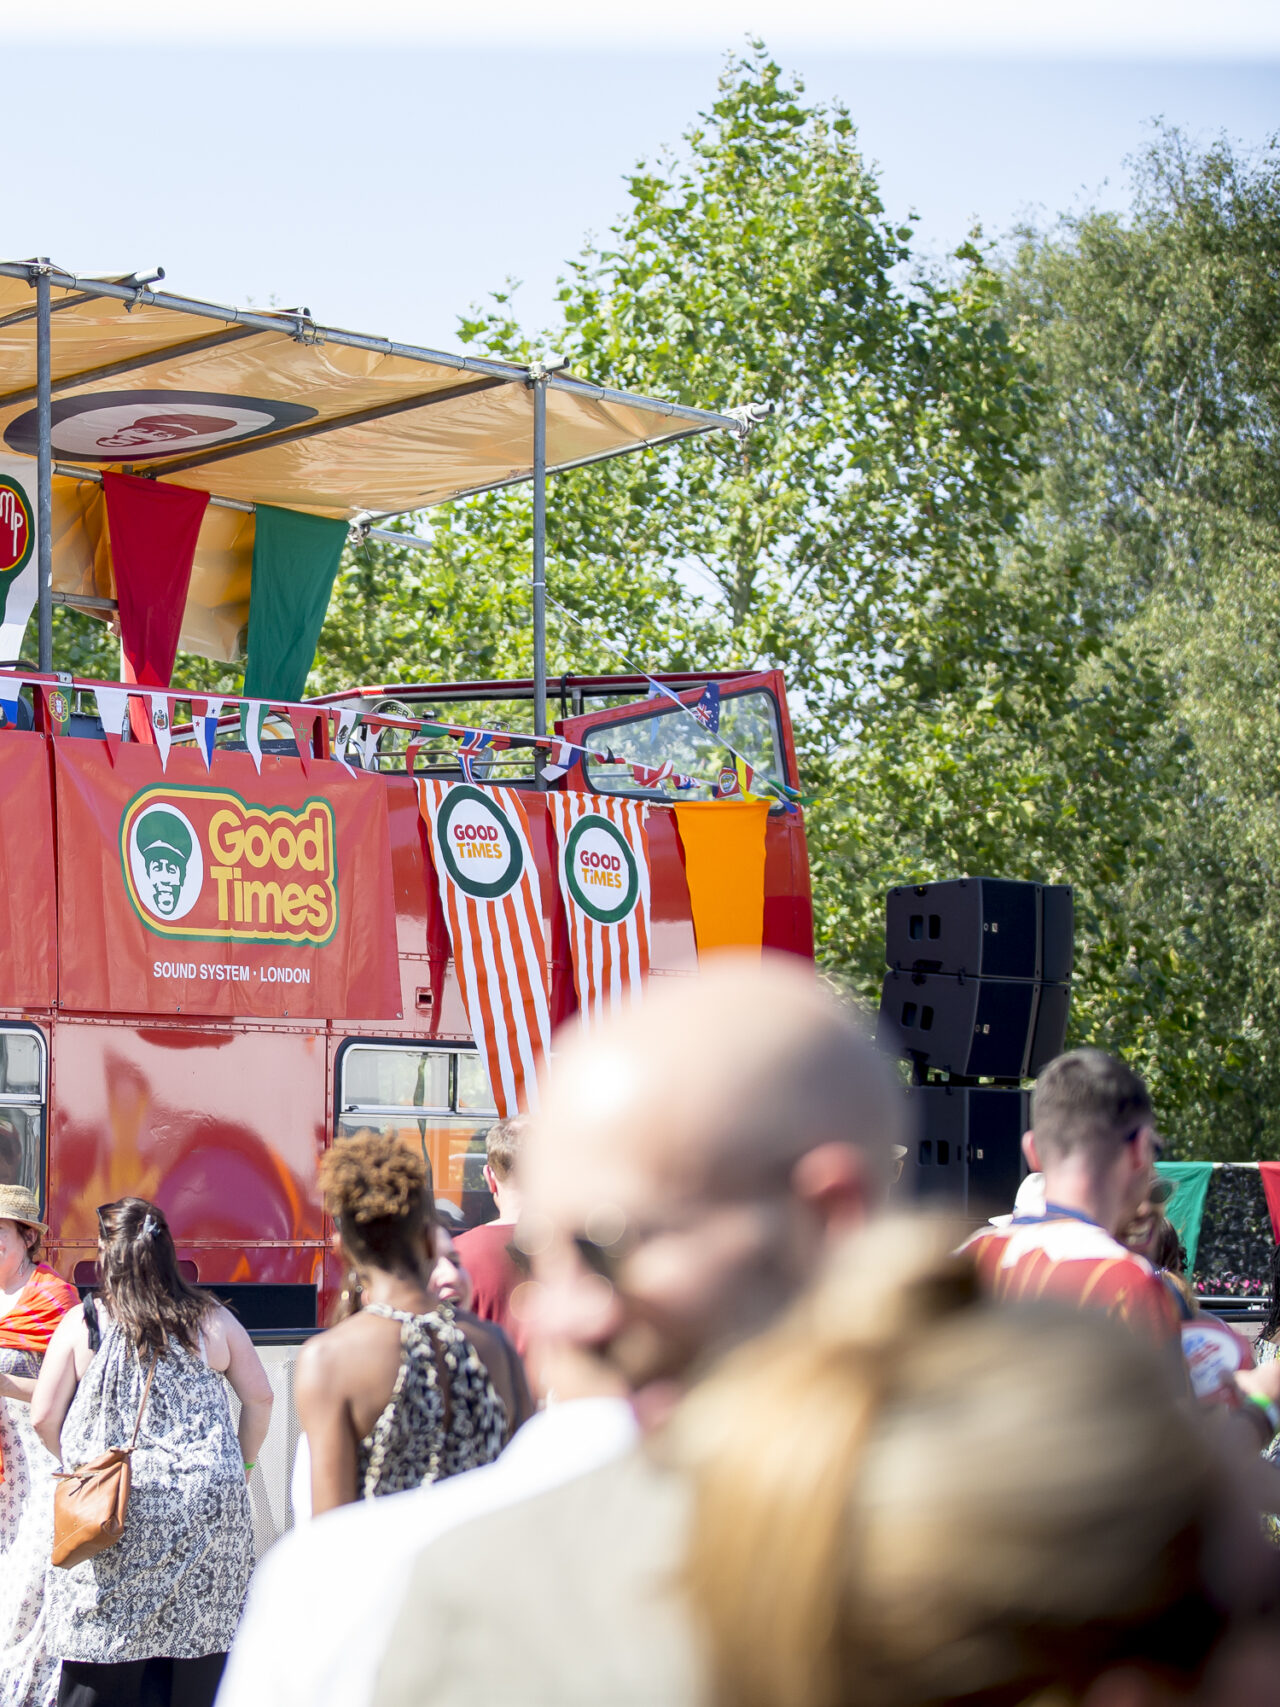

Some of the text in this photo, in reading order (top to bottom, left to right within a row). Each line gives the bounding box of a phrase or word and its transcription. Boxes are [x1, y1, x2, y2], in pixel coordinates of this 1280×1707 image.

[208, 808, 325, 872] Good
[453, 823, 499, 842] GOOD
[579, 849, 621, 872] GOOD
[210, 865, 328, 928] Times
[153, 961, 311, 984] SOUND SYSTEM LONDON
